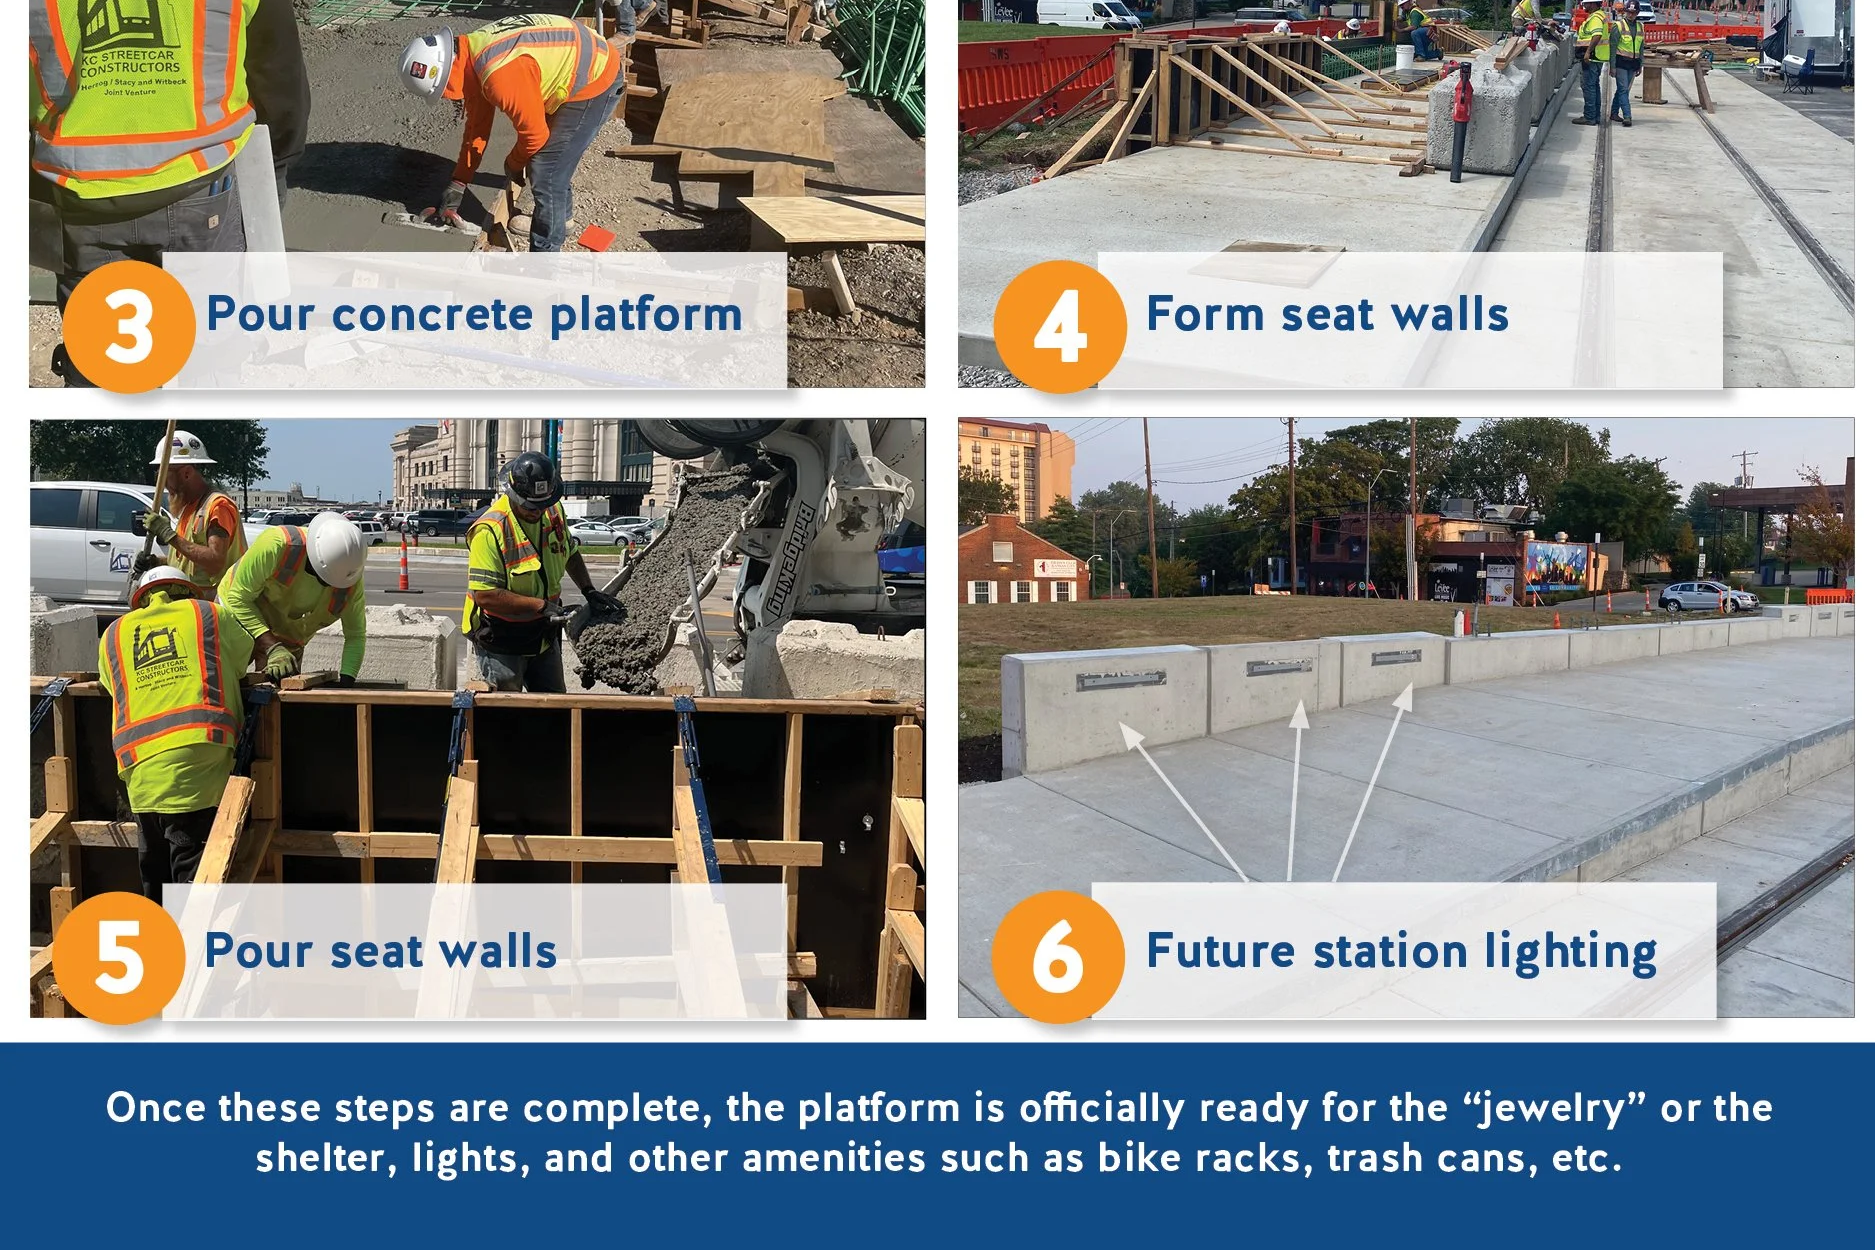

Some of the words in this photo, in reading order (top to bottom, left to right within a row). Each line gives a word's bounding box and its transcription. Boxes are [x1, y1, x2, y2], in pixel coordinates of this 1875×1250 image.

[82, 55, 98, 66] KC
[101, 50, 175, 62] STREETCAR
[80, 62, 181, 79] CONSTRUCTORS
[81, 79, 109, 91] Herzog
[115, 78, 135, 88] Stacy
[139, 78, 153, 86] and
[155, 78, 187, 86] Witbeck
[104, 88, 123, 96] Joint
[125, 88, 157, 97] Venture
[766, 500, 816, 618] BridgeKing
[136, 669, 145, 677] KC
[146, 660, 185, 673] STREETCAR
[136, 665, 189, 683] CONSTRUCTORS
